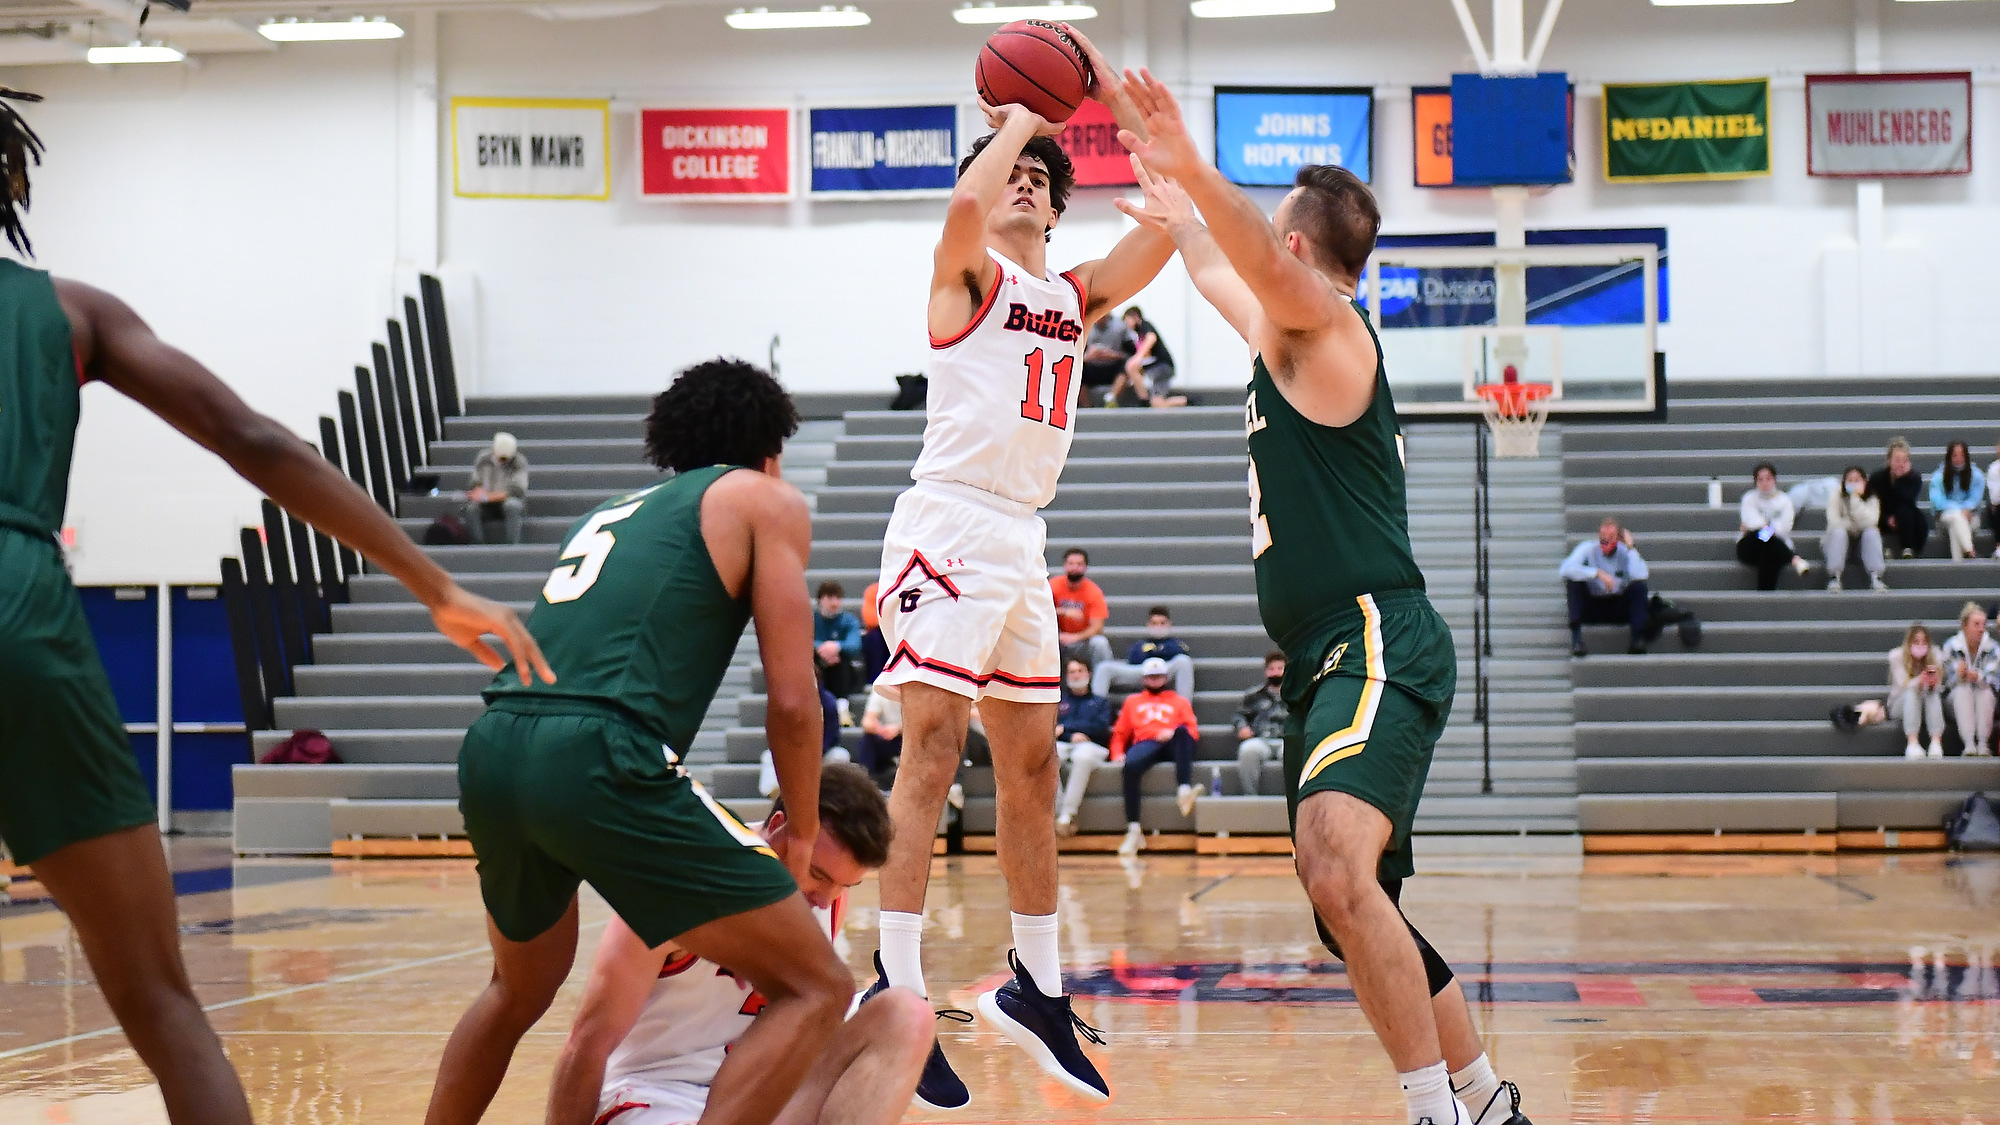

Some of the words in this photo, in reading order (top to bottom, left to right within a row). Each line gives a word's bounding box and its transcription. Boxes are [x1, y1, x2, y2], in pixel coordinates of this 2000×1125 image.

[662, 125, 768, 149] DICKINSON
[1255, 112, 1332, 137] JOHNS
[1827, 108, 1952, 146] MUHLENBERG
[477, 134, 521, 168] BRYN
[530, 135, 584, 168] MAWR
[813, 131, 875, 169] FRANKLIN
[884, 128, 955, 168] MARSHALL
[1243, 143, 1342, 167] HOPKINS
[672, 154, 760, 179] COLLEGE
[1020, 347, 1074, 430] 11
[542, 500, 644, 604] 5
